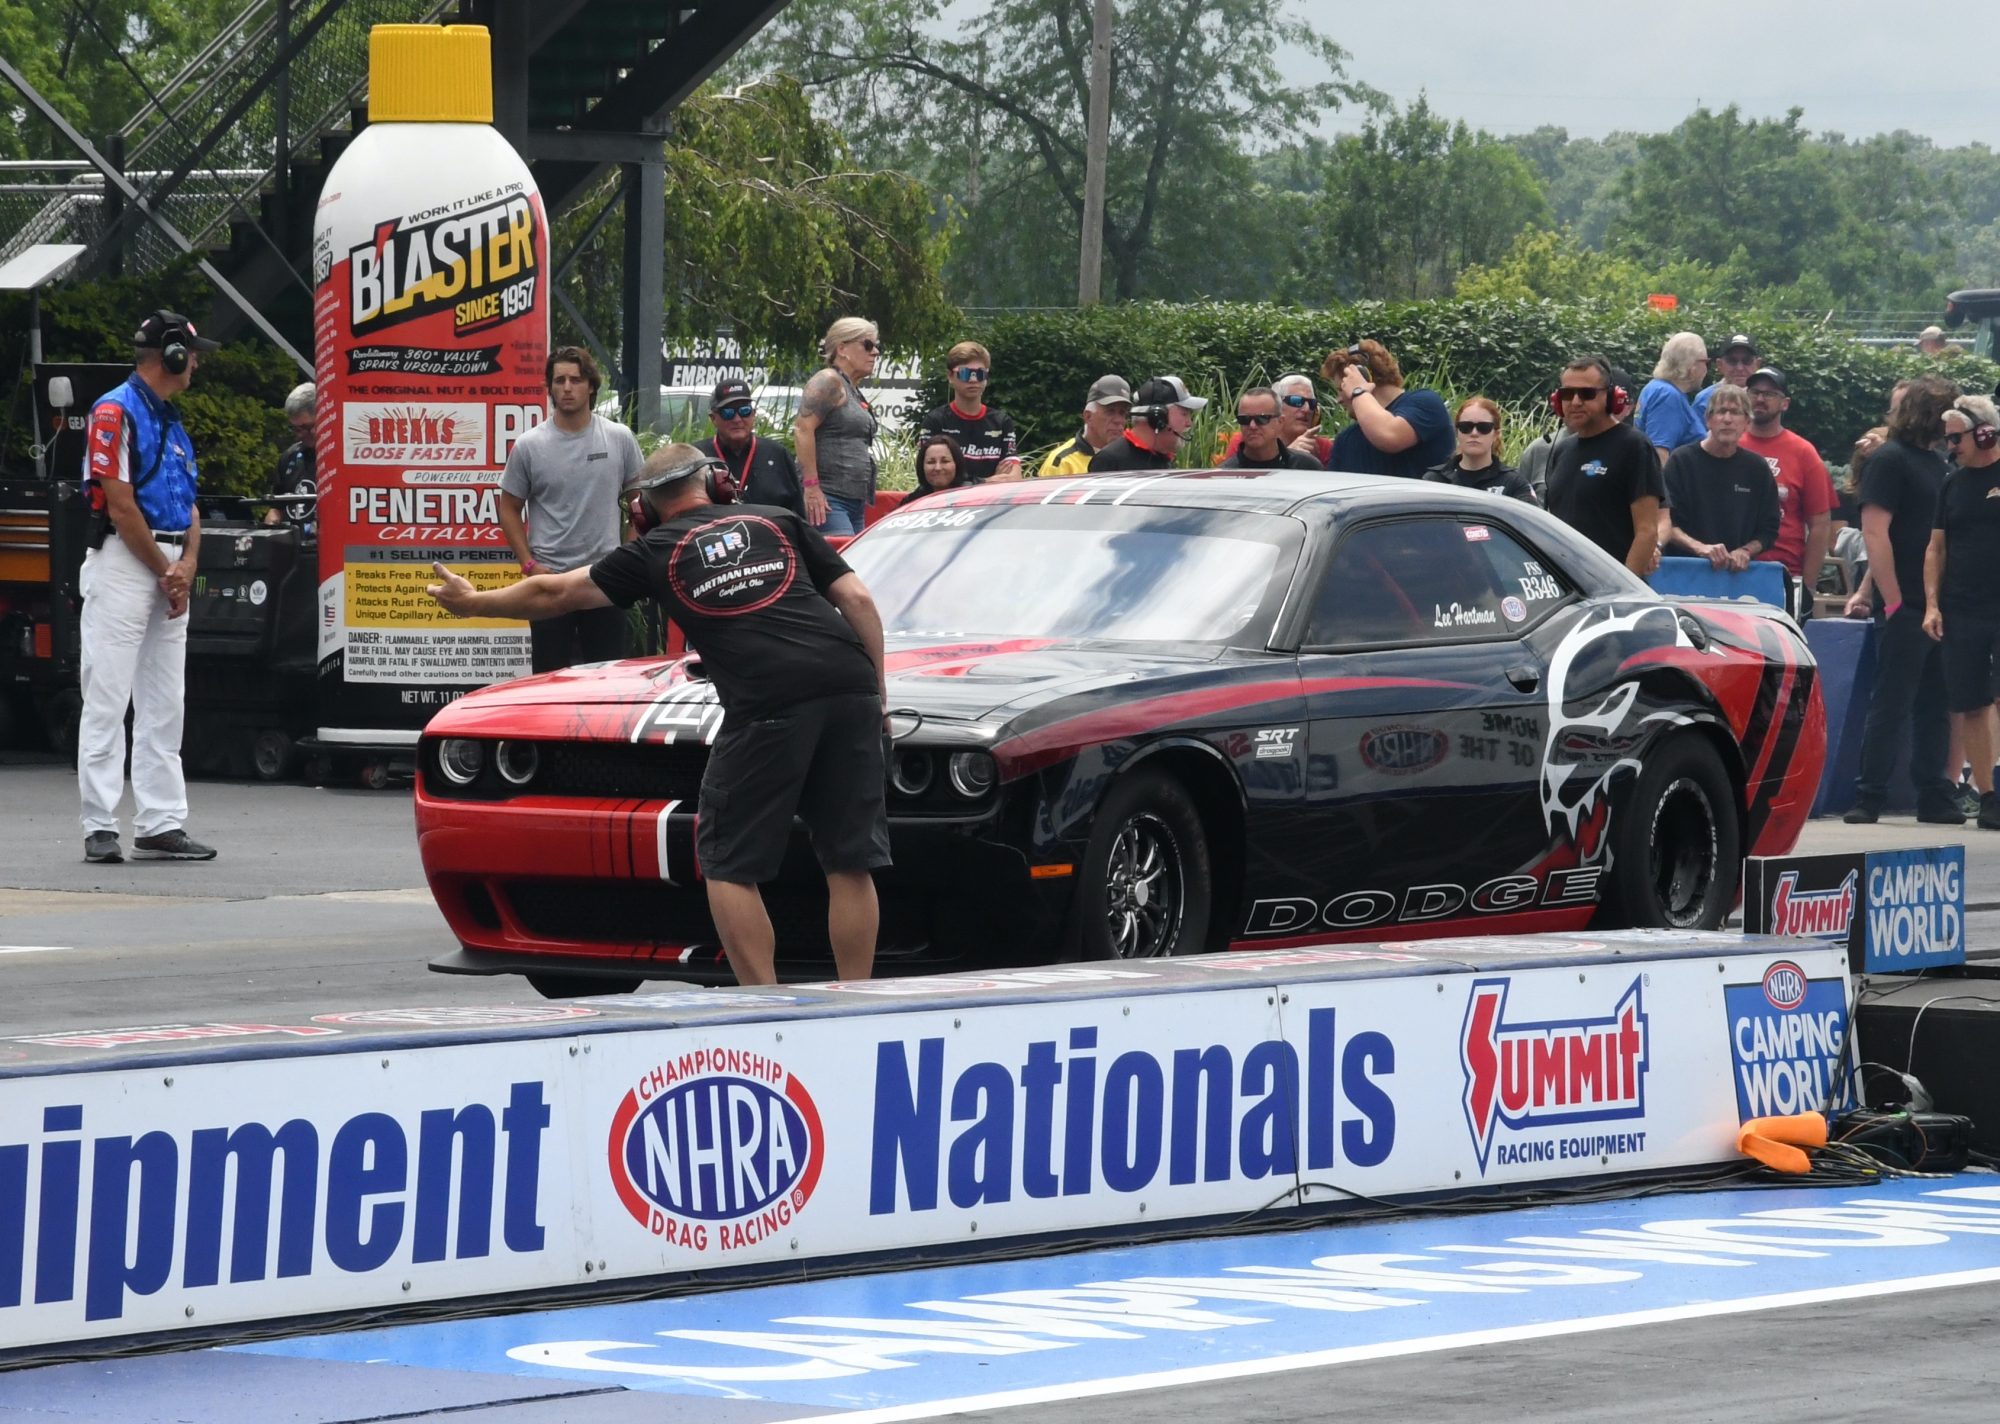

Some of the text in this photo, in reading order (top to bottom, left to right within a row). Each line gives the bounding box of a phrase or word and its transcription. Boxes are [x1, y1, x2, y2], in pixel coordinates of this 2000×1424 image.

[408, 181, 524, 224] WORK IT LIKE A PRO
[455, 276, 535, 326] SINCE 1957
[444, 350, 483, 361] VALVE
[359, 360, 488, 374] SPRAYS UPSIDE-DOWN
[348, 385, 368, 395] THE
[371, 385, 432, 396] ORIGINAL
[437, 386, 464, 396] NUT
[468, 386, 477, 396] &
[480, 386, 509, 396] BOLT
[368, 417, 456, 445] BREAKS
[353, 447, 477, 461] LOOSE FASTER
[414, 471, 471, 482] POWERFUL
[378, 527, 504, 540] CATALYS
[369, 550, 384, 560] #1
[390, 550, 454, 561] SELLING
[355, 570, 386, 580] Breaks
[389, 570, 412, 580] Free
[468, 570, 500, 580] Frozen
[1523, 561, 1543, 576] FSS
[355, 584, 392, 594] Protects
[692, 561, 784, 599] HARTMAN RACING
[1518, 574, 1560, 601] B346
[355, 597, 388, 607] Attacks
[391, 597, 414, 607] Rust
[355, 610, 387, 620] Unique
[389, 610, 434, 622] Capillary
[1434, 603, 1453, 628] Lee
[1450, 602, 1496, 626] Hartman
[348, 631, 383, 644] DANGER:
[432, 636, 456, 645] VAPOR
[494, 636, 524, 645] EXCESSIVE
[348, 646, 360, 654] MAY
[361, 646, 370, 655] BE
[394, 647, 410, 655] MAY
[412, 647, 437, 656] CAUSE
[439, 647, 453, 656] EYE
[455, 647, 470, 656] AND
[472, 647, 489, 656] SKIN
[348, 657, 376, 666] HARMFUL
[377, 657, 387, 666] OR
[388, 658, 409, 667] FATAL
[411, 658, 418, 667] IF
[471, 658, 506, 667] CONTENTS
[507, 657, 525, 667] UNDER
[348, 668, 378, 678] Carefully
[399, 670, 421, 678] other
[401, 690, 419, 704] NET
[420, 690, 438, 704] WT.
[439, 691, 450, 704] 11
[1254, 728, 1299, 745] SRT
[1869, 861, 1959, 908] CAMPING
[1243, 865, 1603, 935] DODGE
[1869, 904, 1960, 957] WORLD
[1770, 971, 1801, 1001] NHRA
[1735, 1011, 1844, 1063] CAMPING
[638, 1047, 783, 1101] CHAMPIONSHIP
[869, 1007, 1396, 1216] Nationals
[643, 1084, 797, 1213] NHRA
[1497, 1131, 1646, 1166] RACING EQUIPMENT
[0, 1081, 551, 1322] ipment
[651, 1199, 792, 1252] DRAG RACING
[505, 1253, 1644, 1381] CAMPING
